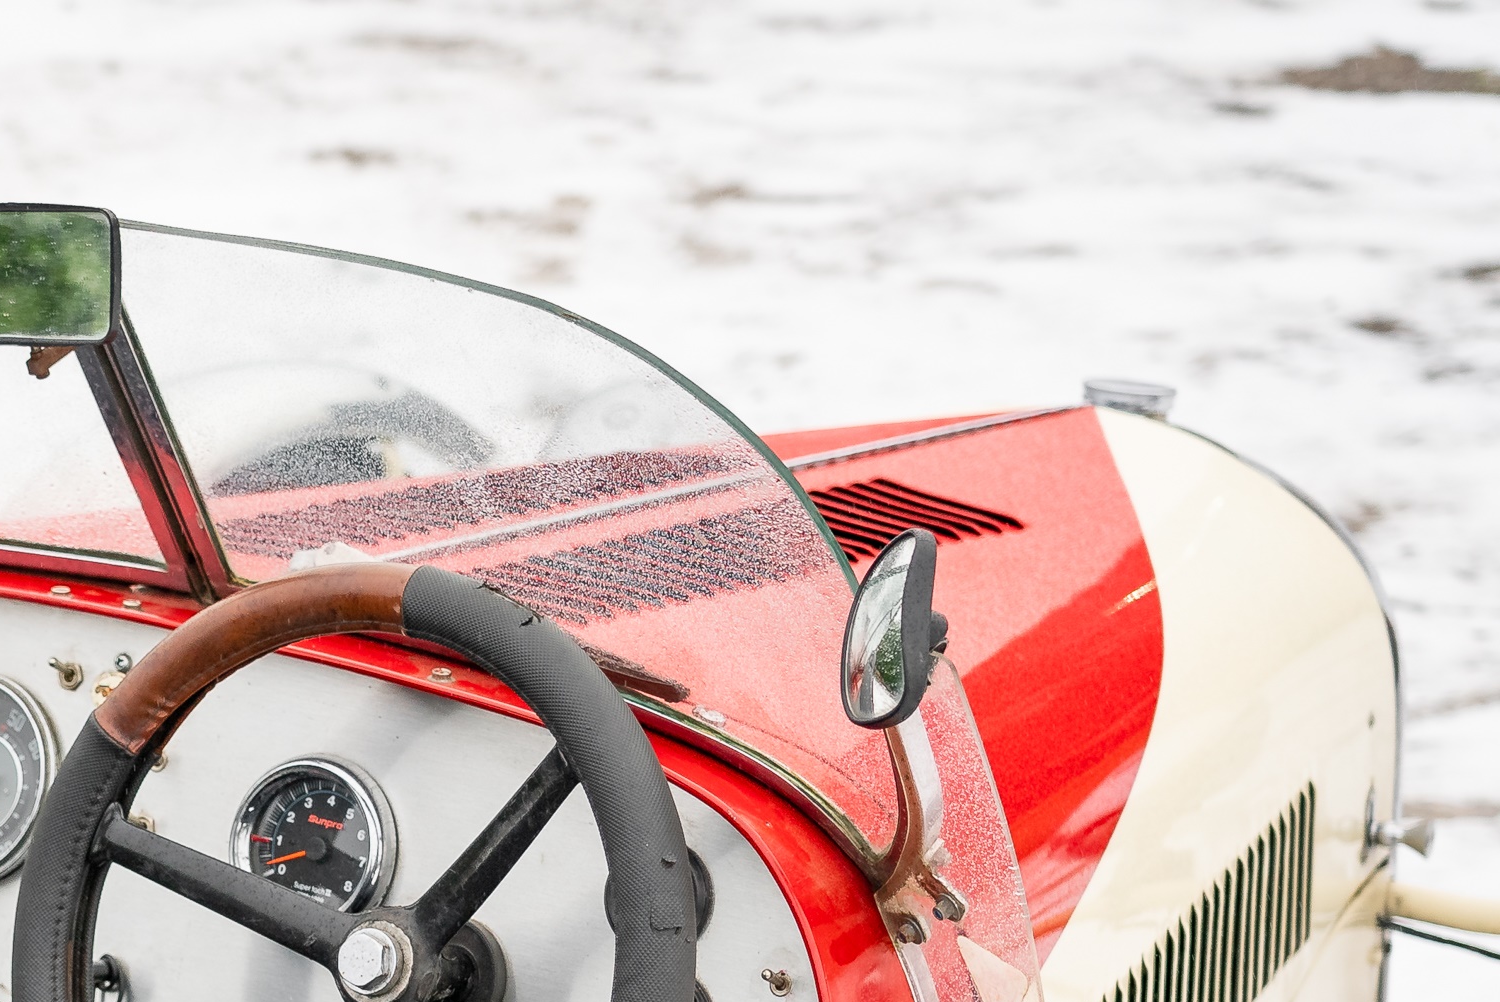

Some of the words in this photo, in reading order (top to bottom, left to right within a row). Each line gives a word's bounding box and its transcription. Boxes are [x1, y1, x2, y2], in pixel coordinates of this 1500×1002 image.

[7, 709, 26, 733] 50
[304, 797, 313, 809] 3
[327, 795, 336, 807] 4
[286, 811, 295, 823] 2
[345, 808, 355, 820] 5
[307, 814, 344, 830] Sunpro
[276, 835, 283, 846] 1
[357, 829, 366, 841] 6
[358, 856, 367, 868] 7
[277, 864, 287, 876] 0
[293, 880, 311, 891] Super
[343, 880, 353, 893] 8
